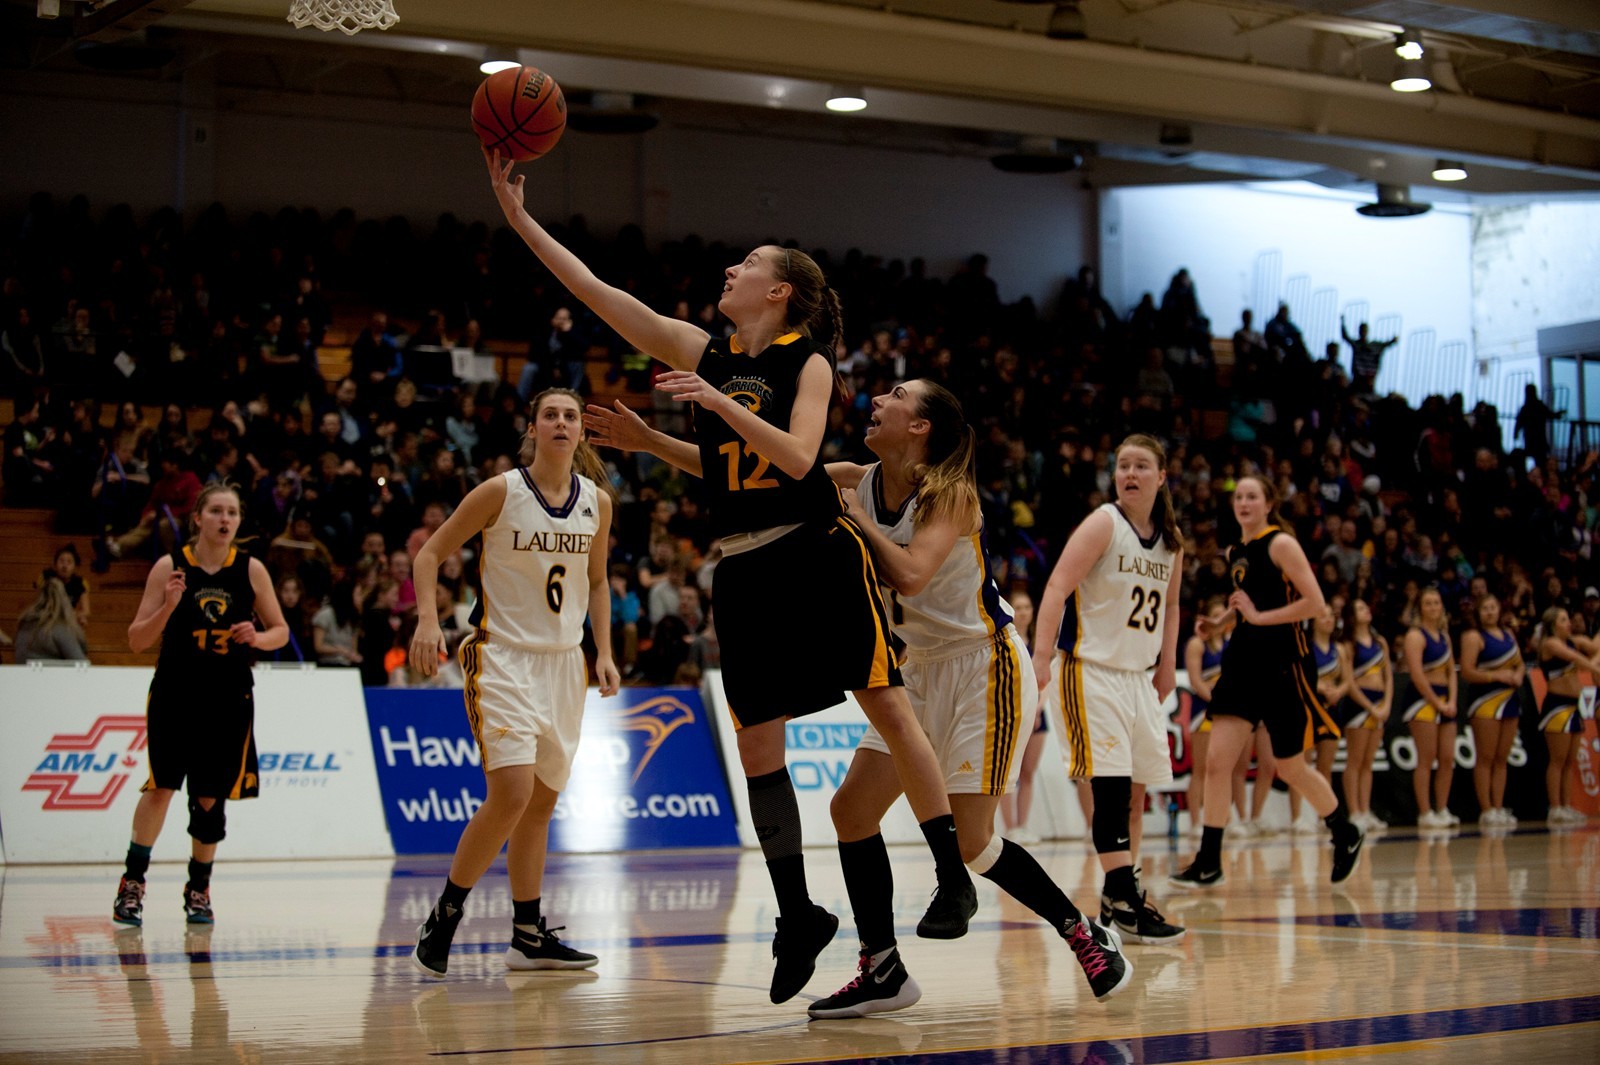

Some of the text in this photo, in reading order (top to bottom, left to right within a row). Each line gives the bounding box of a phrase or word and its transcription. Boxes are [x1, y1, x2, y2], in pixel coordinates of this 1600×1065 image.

[718, 440, 780, 491] 12
[546, 564, 566, 615] 6
[1118, 555, 1170, 582] LAURIE
[1127, 584, 1161, 633] 23
[192, 628, 234, 655] 13
[36, 752, 341, 772] AMJ BELL
[379, 726, 483, 768] Haw
